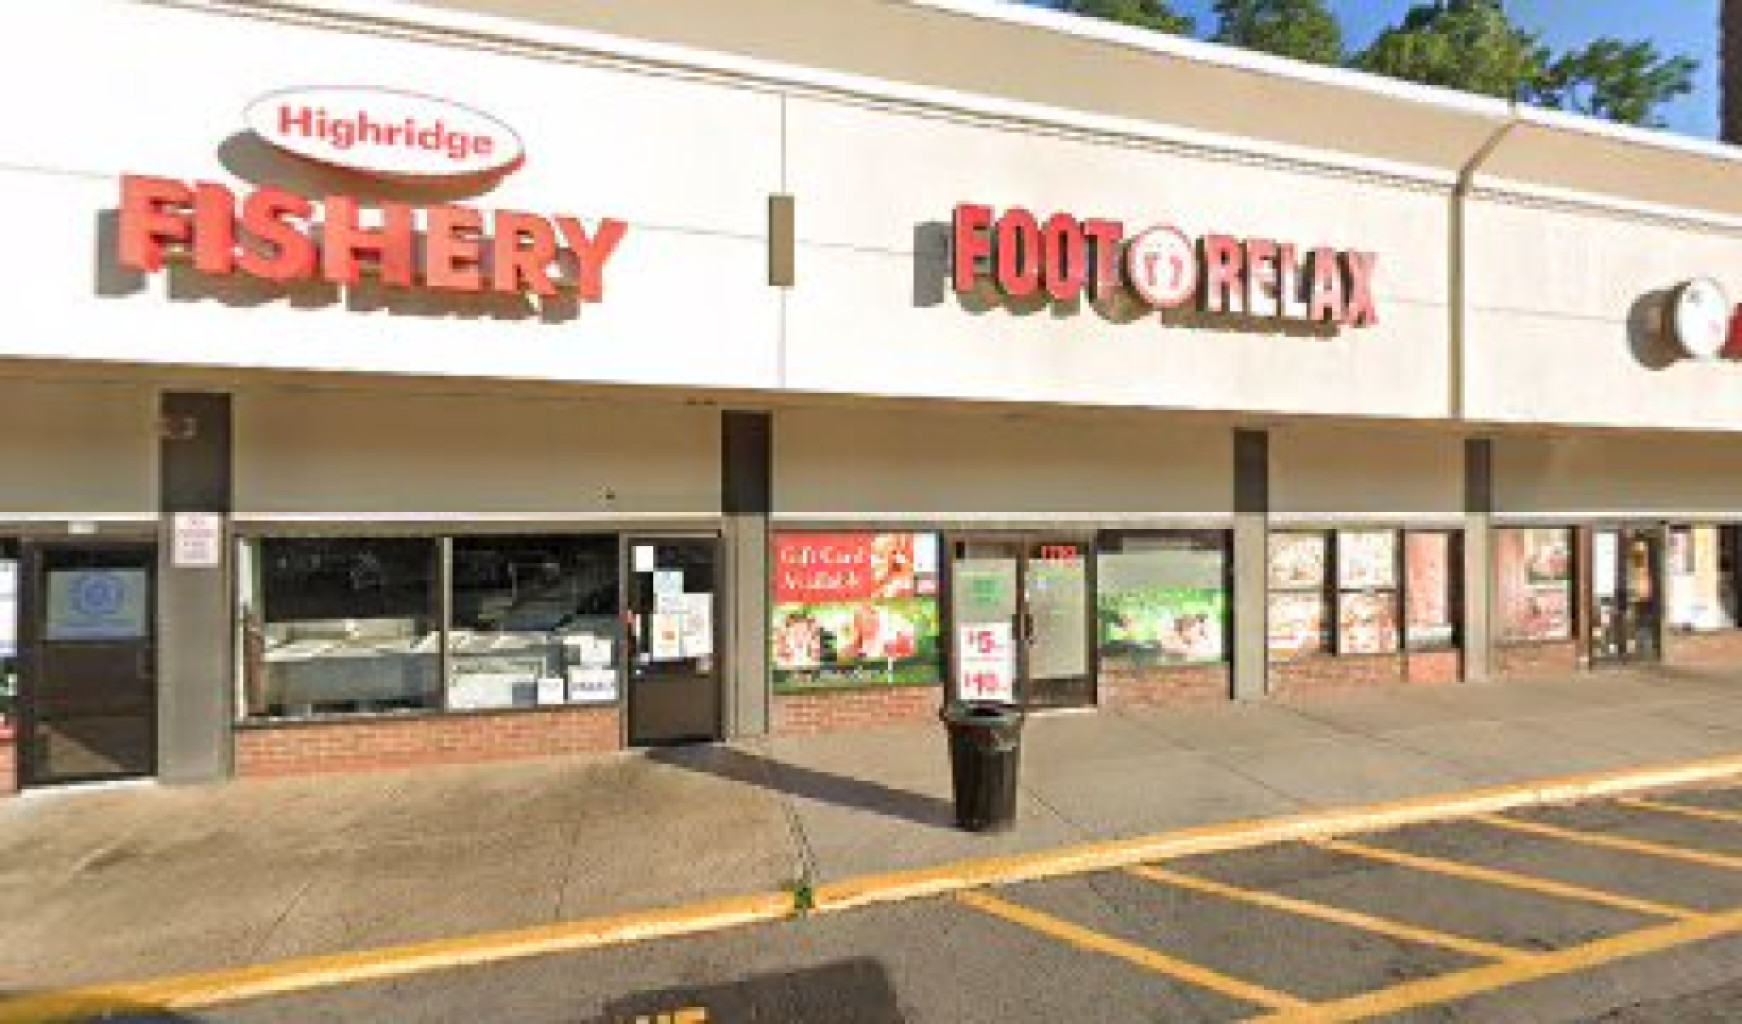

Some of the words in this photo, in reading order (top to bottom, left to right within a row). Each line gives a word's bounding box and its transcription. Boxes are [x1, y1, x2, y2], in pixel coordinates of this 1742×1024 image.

[277, 104, 495, 159] Highridge
[118, 173, 628, 303] FISHERY
[953, 203, 1124, 300] FOOT
[1197, 232, 1380, 329] RELAX
